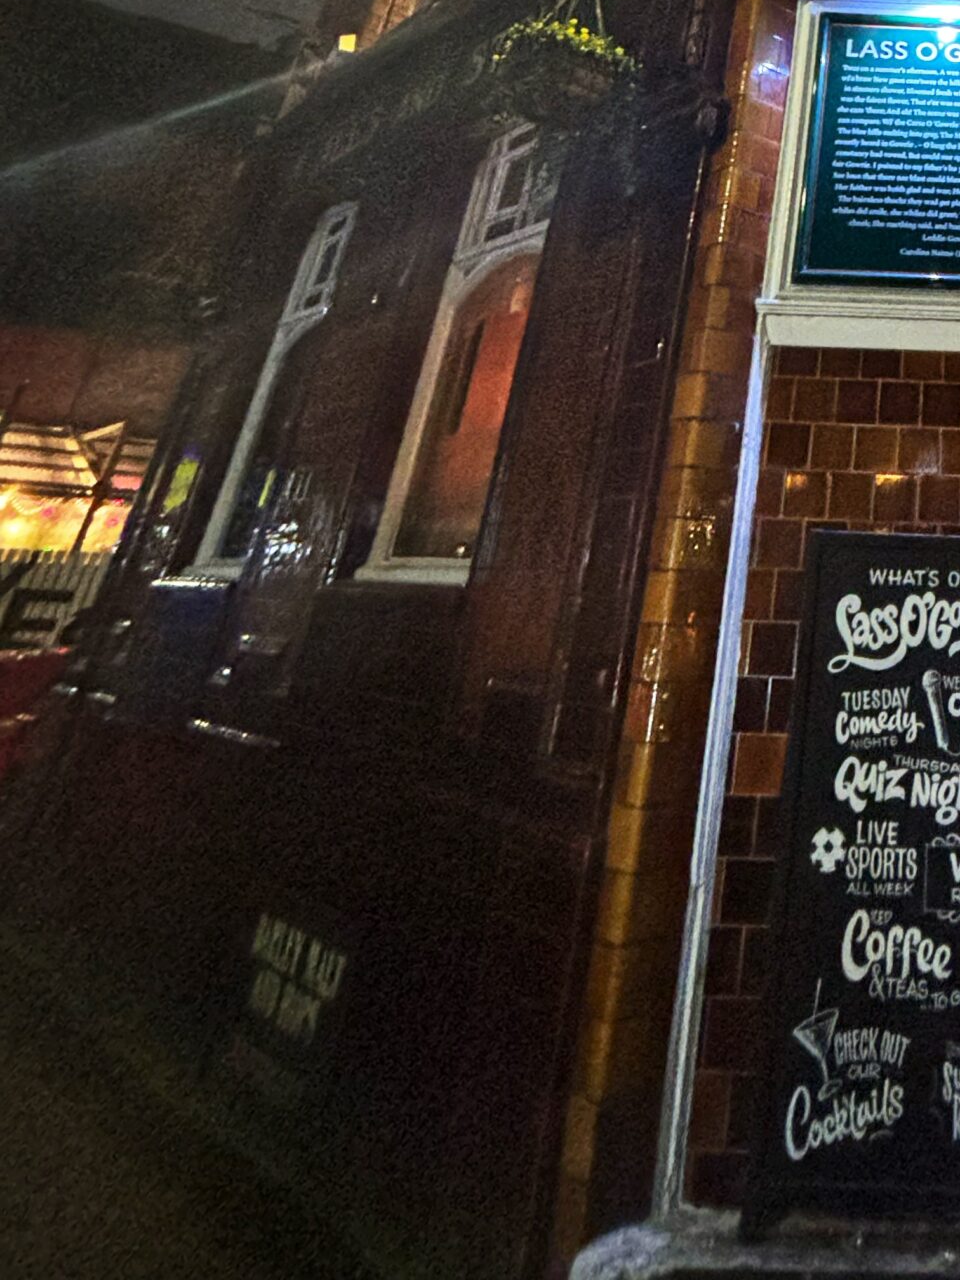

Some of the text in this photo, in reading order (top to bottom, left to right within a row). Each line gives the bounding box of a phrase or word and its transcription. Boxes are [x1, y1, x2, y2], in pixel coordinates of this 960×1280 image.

[845, 38, 909, 60] LASS
[869, 567, 939, 588] WHAT'S
[841, 686, 911, 711] TUESDAY
[835, 708, 925, 745] Comedy
[850, 735, 899, 749] NIGHTS
[834, 755, 908, 813] Quiz
[856, 820, 900, 846] LIVE
[845, 846, 918, 880] SPORTS
[846, 882, 913, 897] ALL WEEK
[842, 908, 953, 982] Coffee
[886, 976, 929, 1001] TEAS
[834, 1027, 877, 1066] CHECK
[879, 1031, 912, 1068] OUT
[847, 1064, 881, 1080] OUR
[785, 1077, 904, 1162] Cocktails
